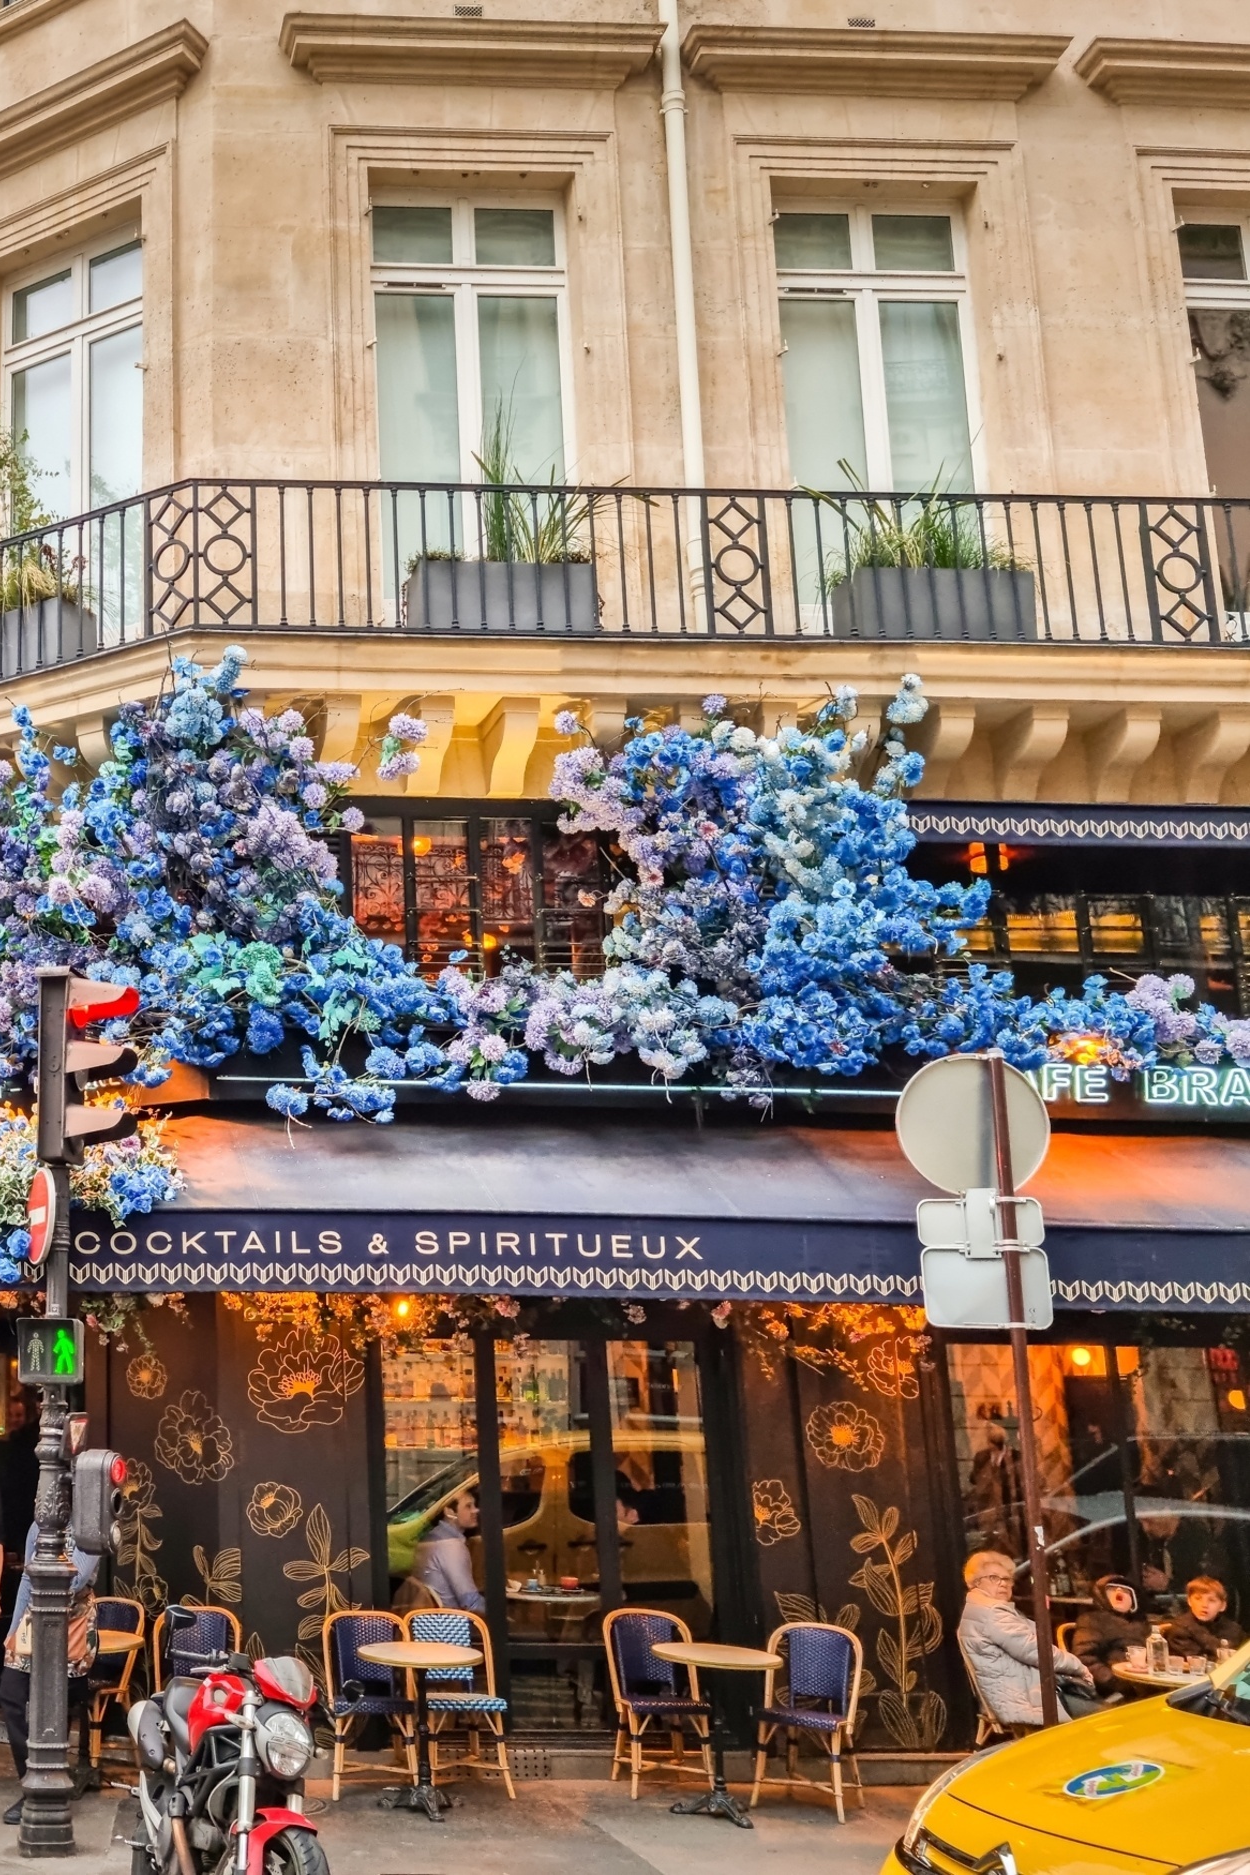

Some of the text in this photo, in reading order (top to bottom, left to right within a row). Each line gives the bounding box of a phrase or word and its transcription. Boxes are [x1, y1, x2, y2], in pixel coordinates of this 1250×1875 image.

[74, 1230, 703, 1260] COCKTAILS & SPIRITUEUX
